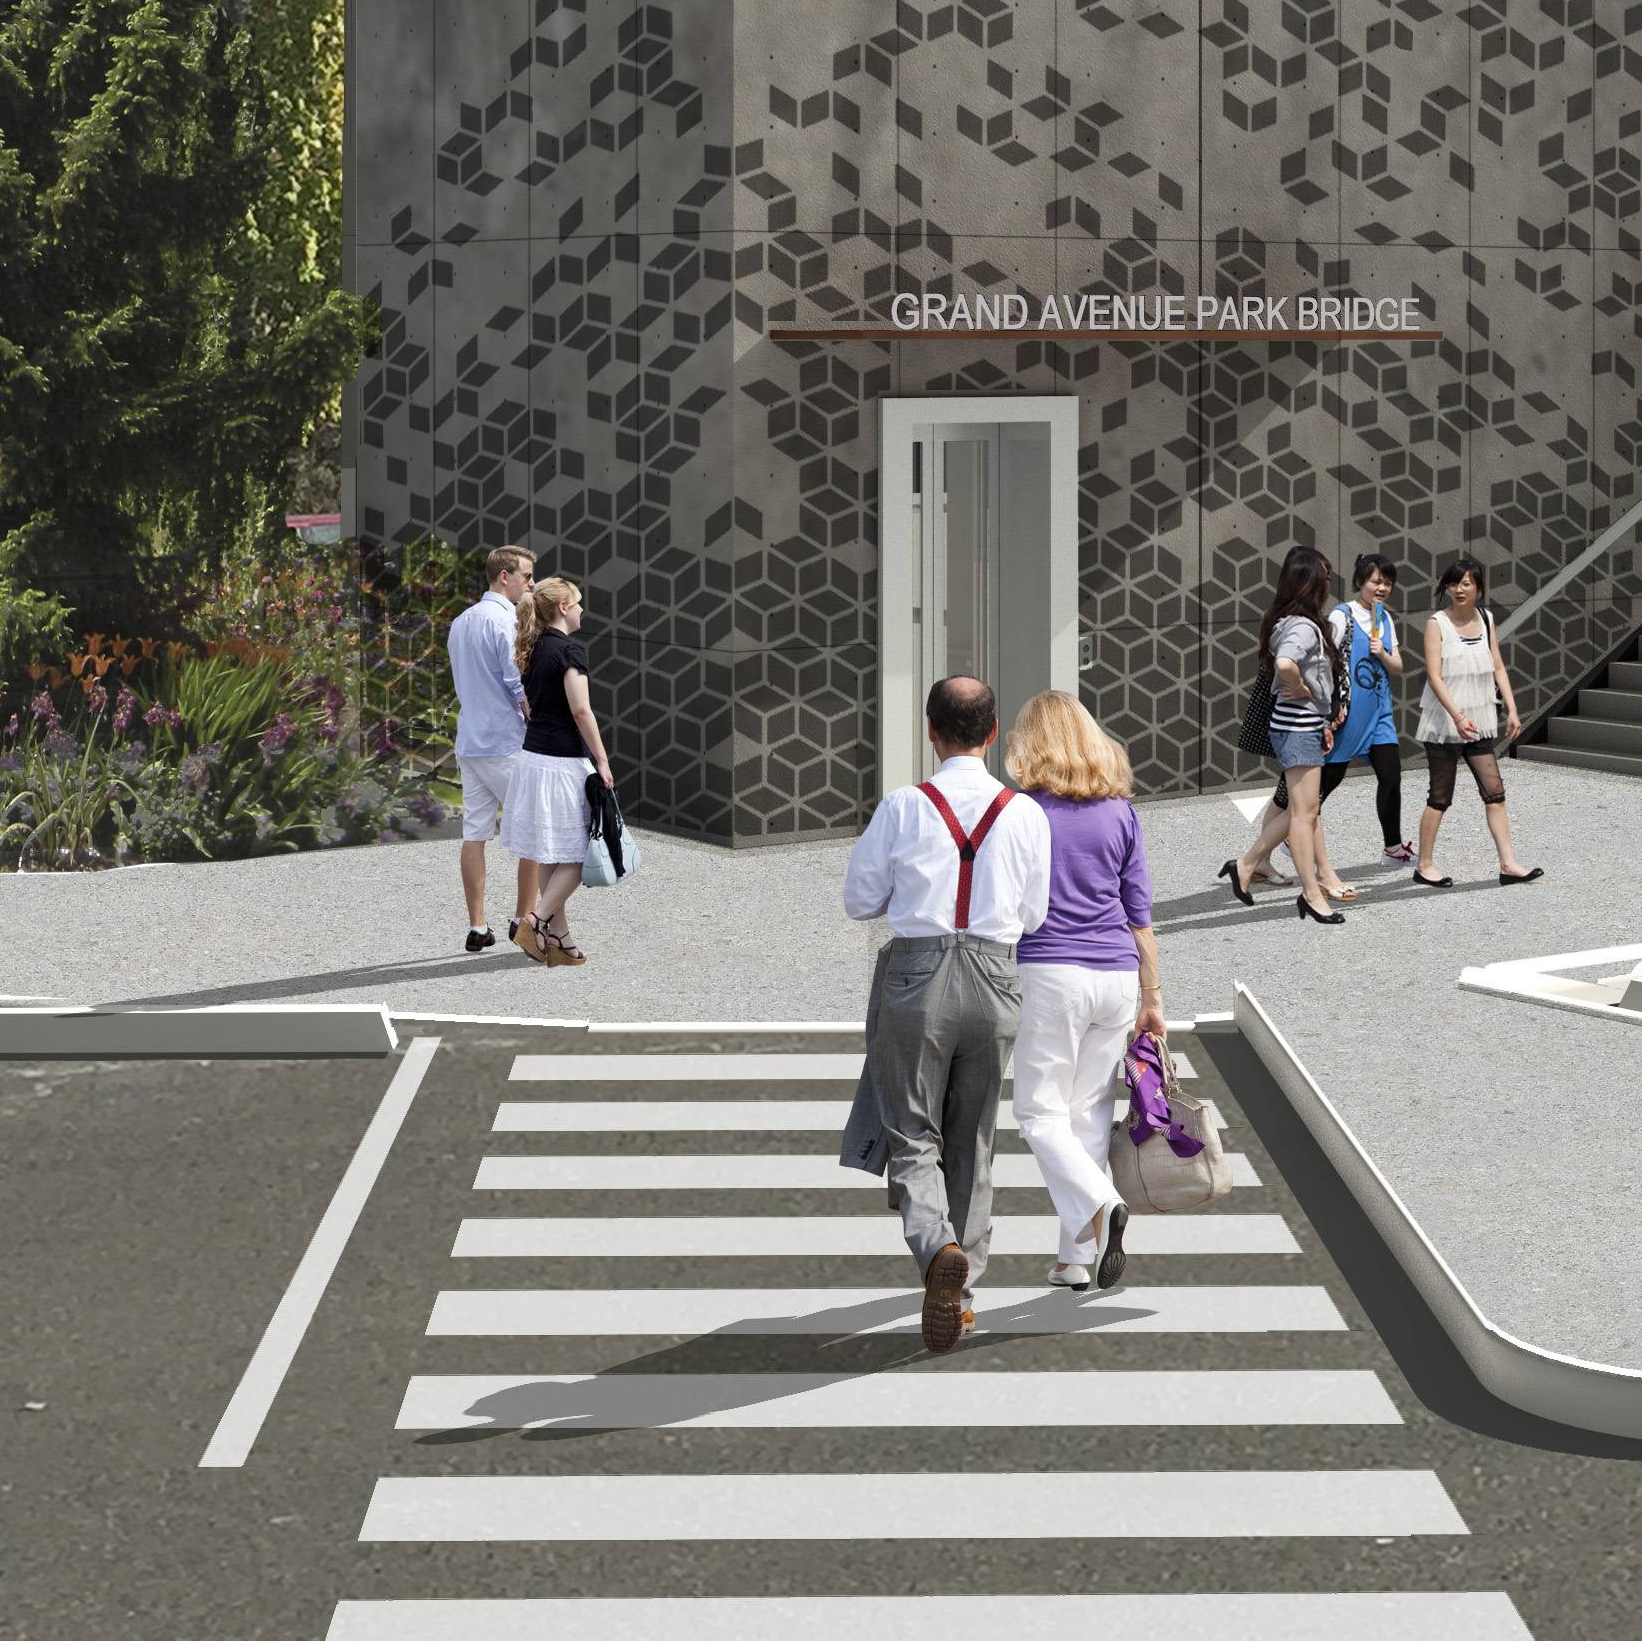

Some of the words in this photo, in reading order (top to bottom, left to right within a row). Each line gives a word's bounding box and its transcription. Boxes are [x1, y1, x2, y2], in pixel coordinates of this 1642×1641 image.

[891, 292, 1029, 331] GRAND
[1037, 294, 1186, 331] AVENUE
[1197, 295, 1289, 331] PARK
[1298, 296, 1421, 331] BRIDGE
